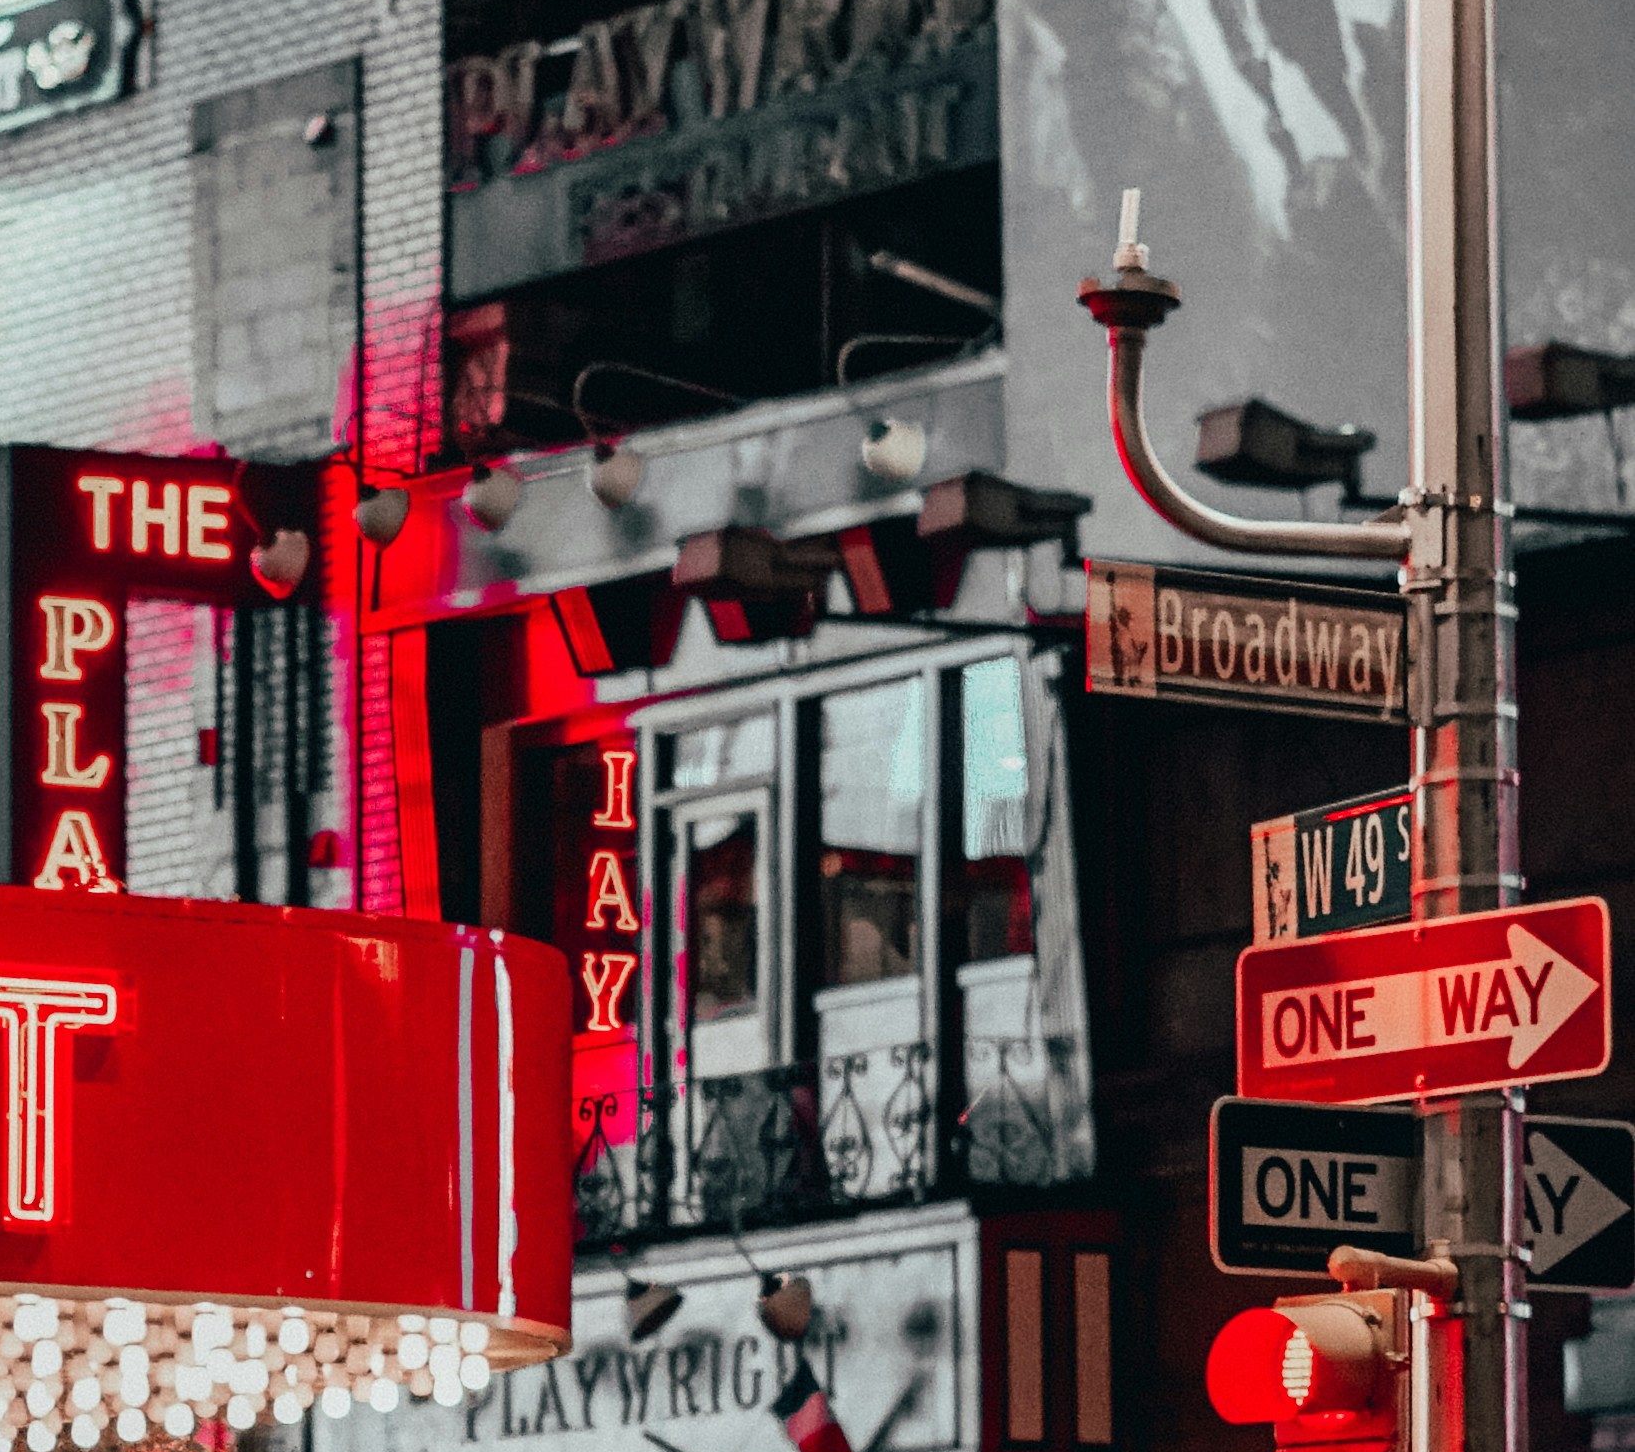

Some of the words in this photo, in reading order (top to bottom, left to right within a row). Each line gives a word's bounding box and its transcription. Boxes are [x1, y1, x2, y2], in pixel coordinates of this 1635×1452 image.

[77, 475, 233, 561] THE
[1158, 588, 1402, 721] Broadway
[1301, 825, 1335, 919] W
[1344, 812, 1385, 908] 49
[1272, 986, 1377, 1060] ONE
[1438, 960, 1554, 1038] WAY
[1255, 1154, 1380, 1225] ONE
[464, 1320, 844, 1442] PLAYWRIGT
